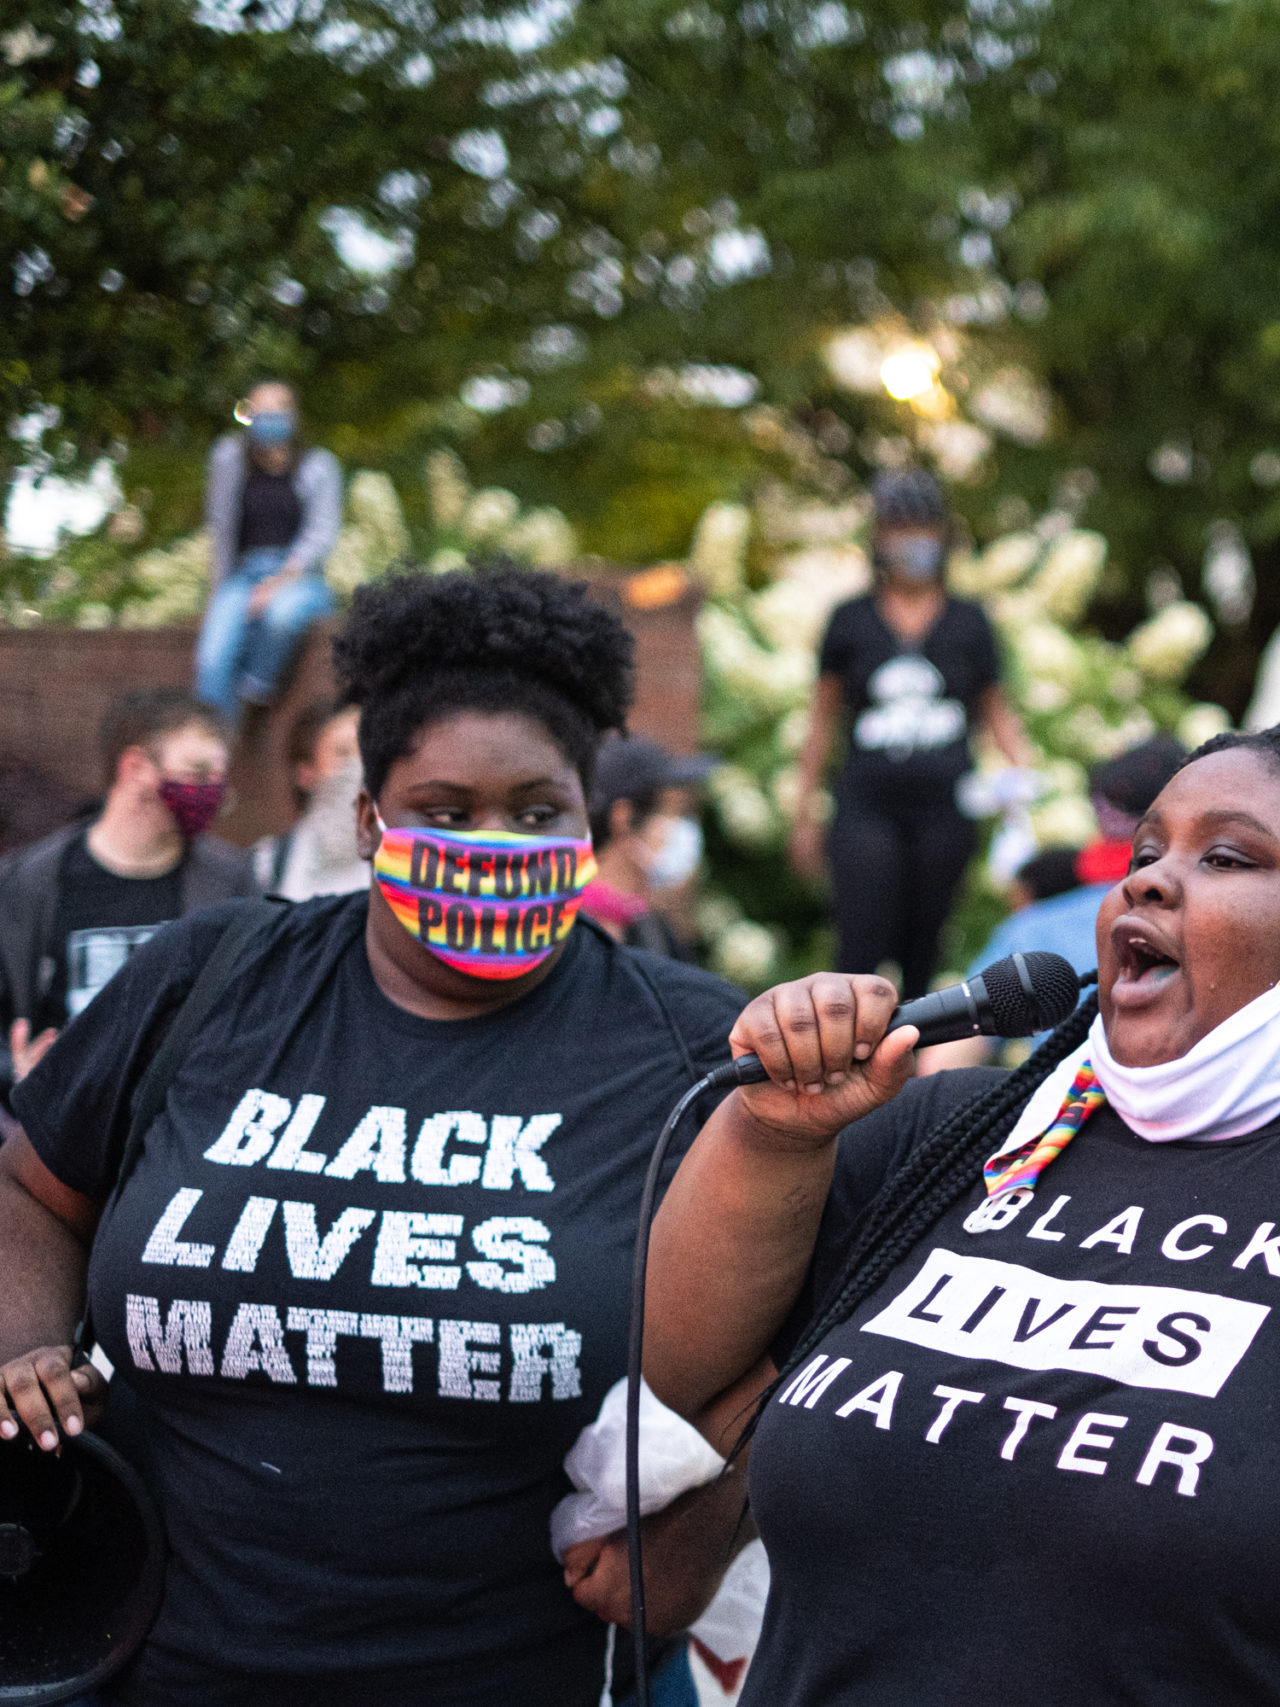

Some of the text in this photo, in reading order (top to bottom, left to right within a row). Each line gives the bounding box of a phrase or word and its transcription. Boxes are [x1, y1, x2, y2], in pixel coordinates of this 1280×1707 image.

[409, 838, 578, 899] DEFUND
[418, 897, 568, 955] POLICE
[203, 1088, 563, 1192] BLACK
[142, 1187, 557, 1293] LIVES
[126, 1294, 581, 1400] MATTER
[907, 1274, 1211, 1367] LIVES
[779, 1354, 1214, 1496] MATTER
